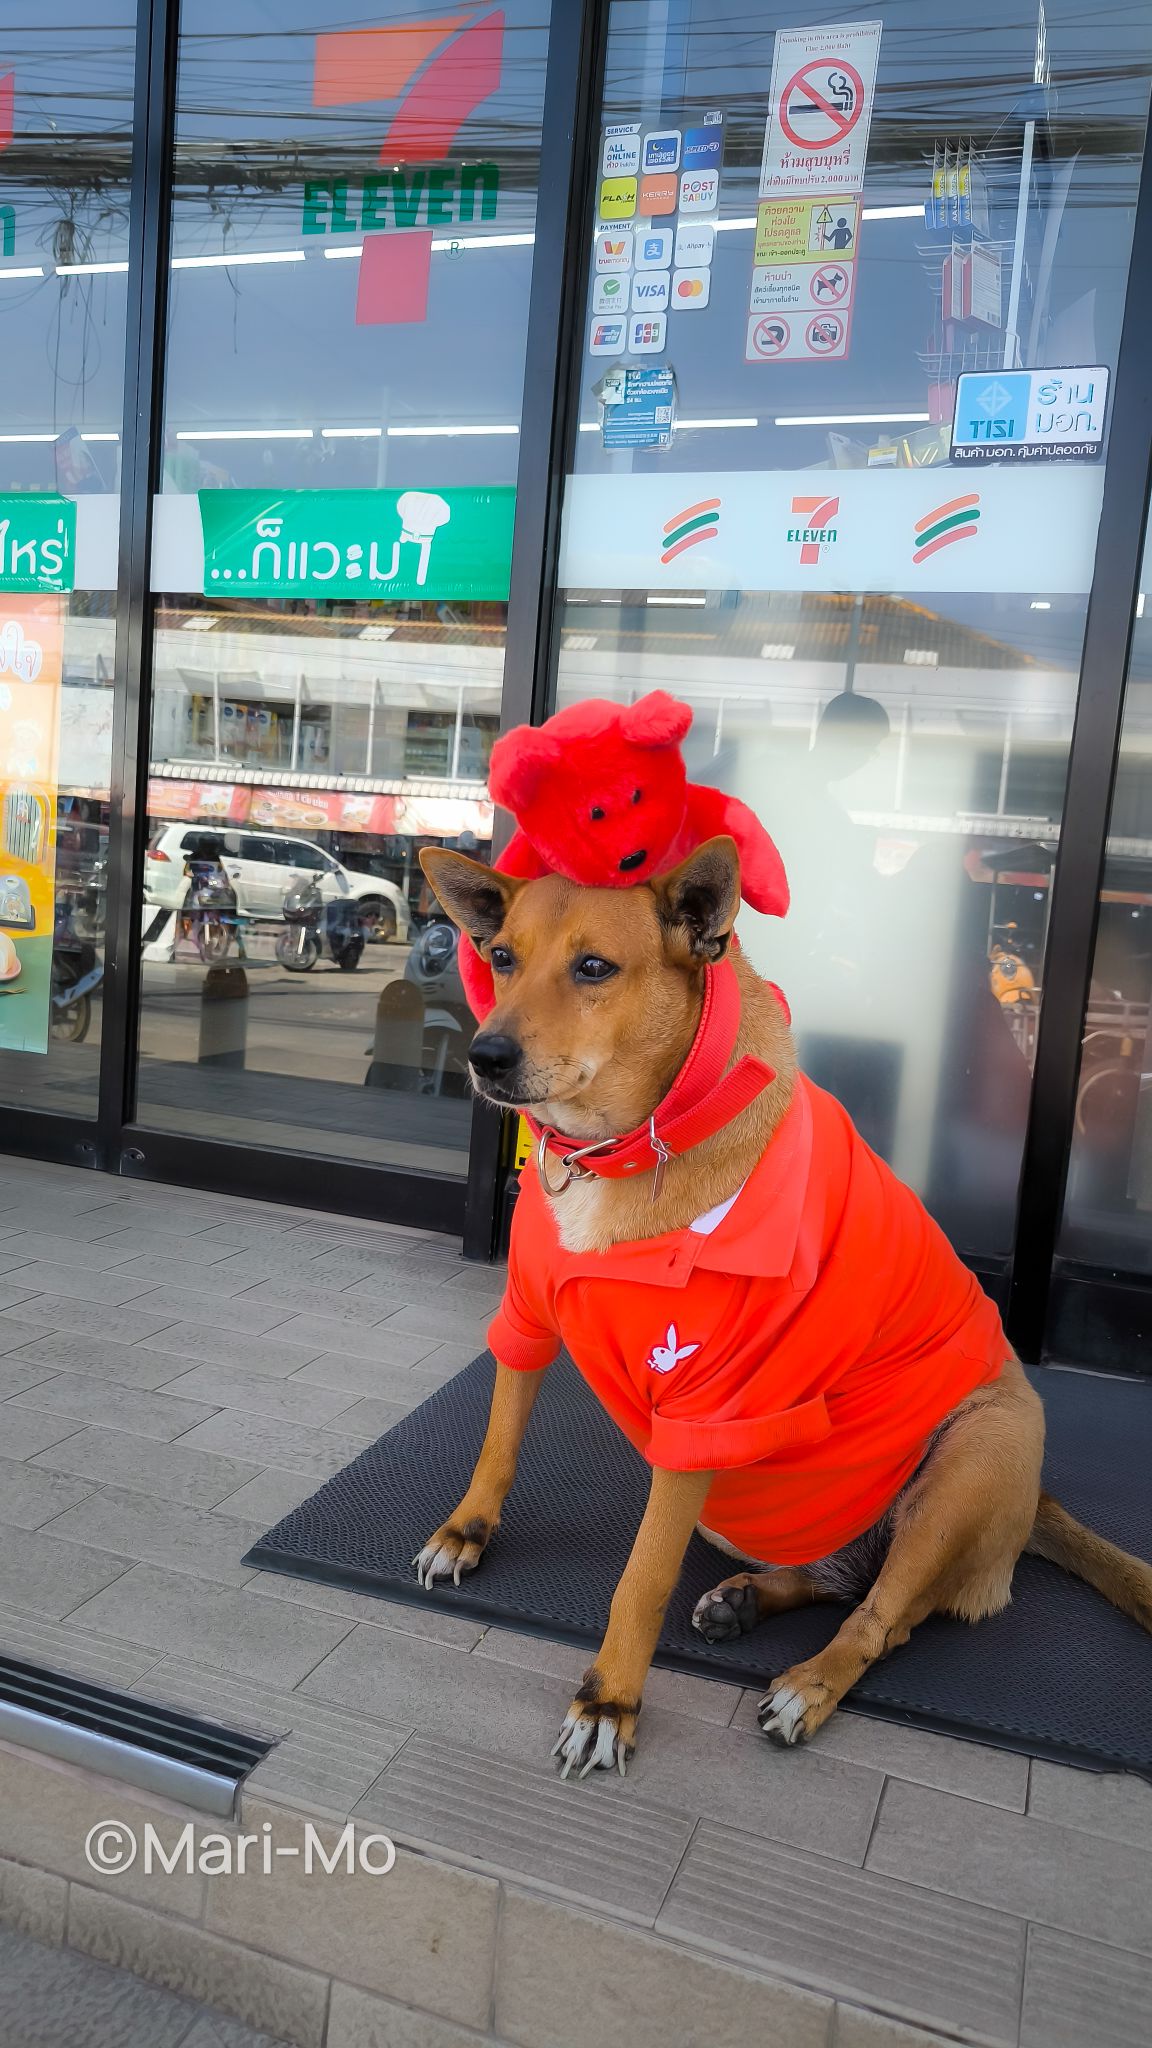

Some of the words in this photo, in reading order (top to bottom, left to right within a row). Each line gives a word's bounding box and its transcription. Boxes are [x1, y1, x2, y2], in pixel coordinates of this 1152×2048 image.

[607, 126, 634, 135] SERVICE
[608, 144, 625, 153] ALL
[606, 152, 637, 161] ONLINE
[780, 144, 851, 171] ห้ามสูบบุหรี่
[820, 174, 843, 184] 2,000
[683, 181, 715, 193] POST
[682, 192, 714, 202] SABUY
[771, 215, 796, 226] ห่วงใย
[600, 223, 631, 231] PAYMENT
[764, 228, 801, 239] โปรดดูแล
[764, 270, 792, 282] ห้ามนำ
[636, 284, 666, 298] VISA
[1038, 379, 1095, 405] ร้าน
[1036, 411, 1097, 433] มอก.
[969, 419, 1015, 439] TISI
[954, 446, 985, 459] สินค้า
[986, 448, 1016, 458] มอก.
[1017, 443, 1097, 459] คุ้มค่าปลอดภัย
